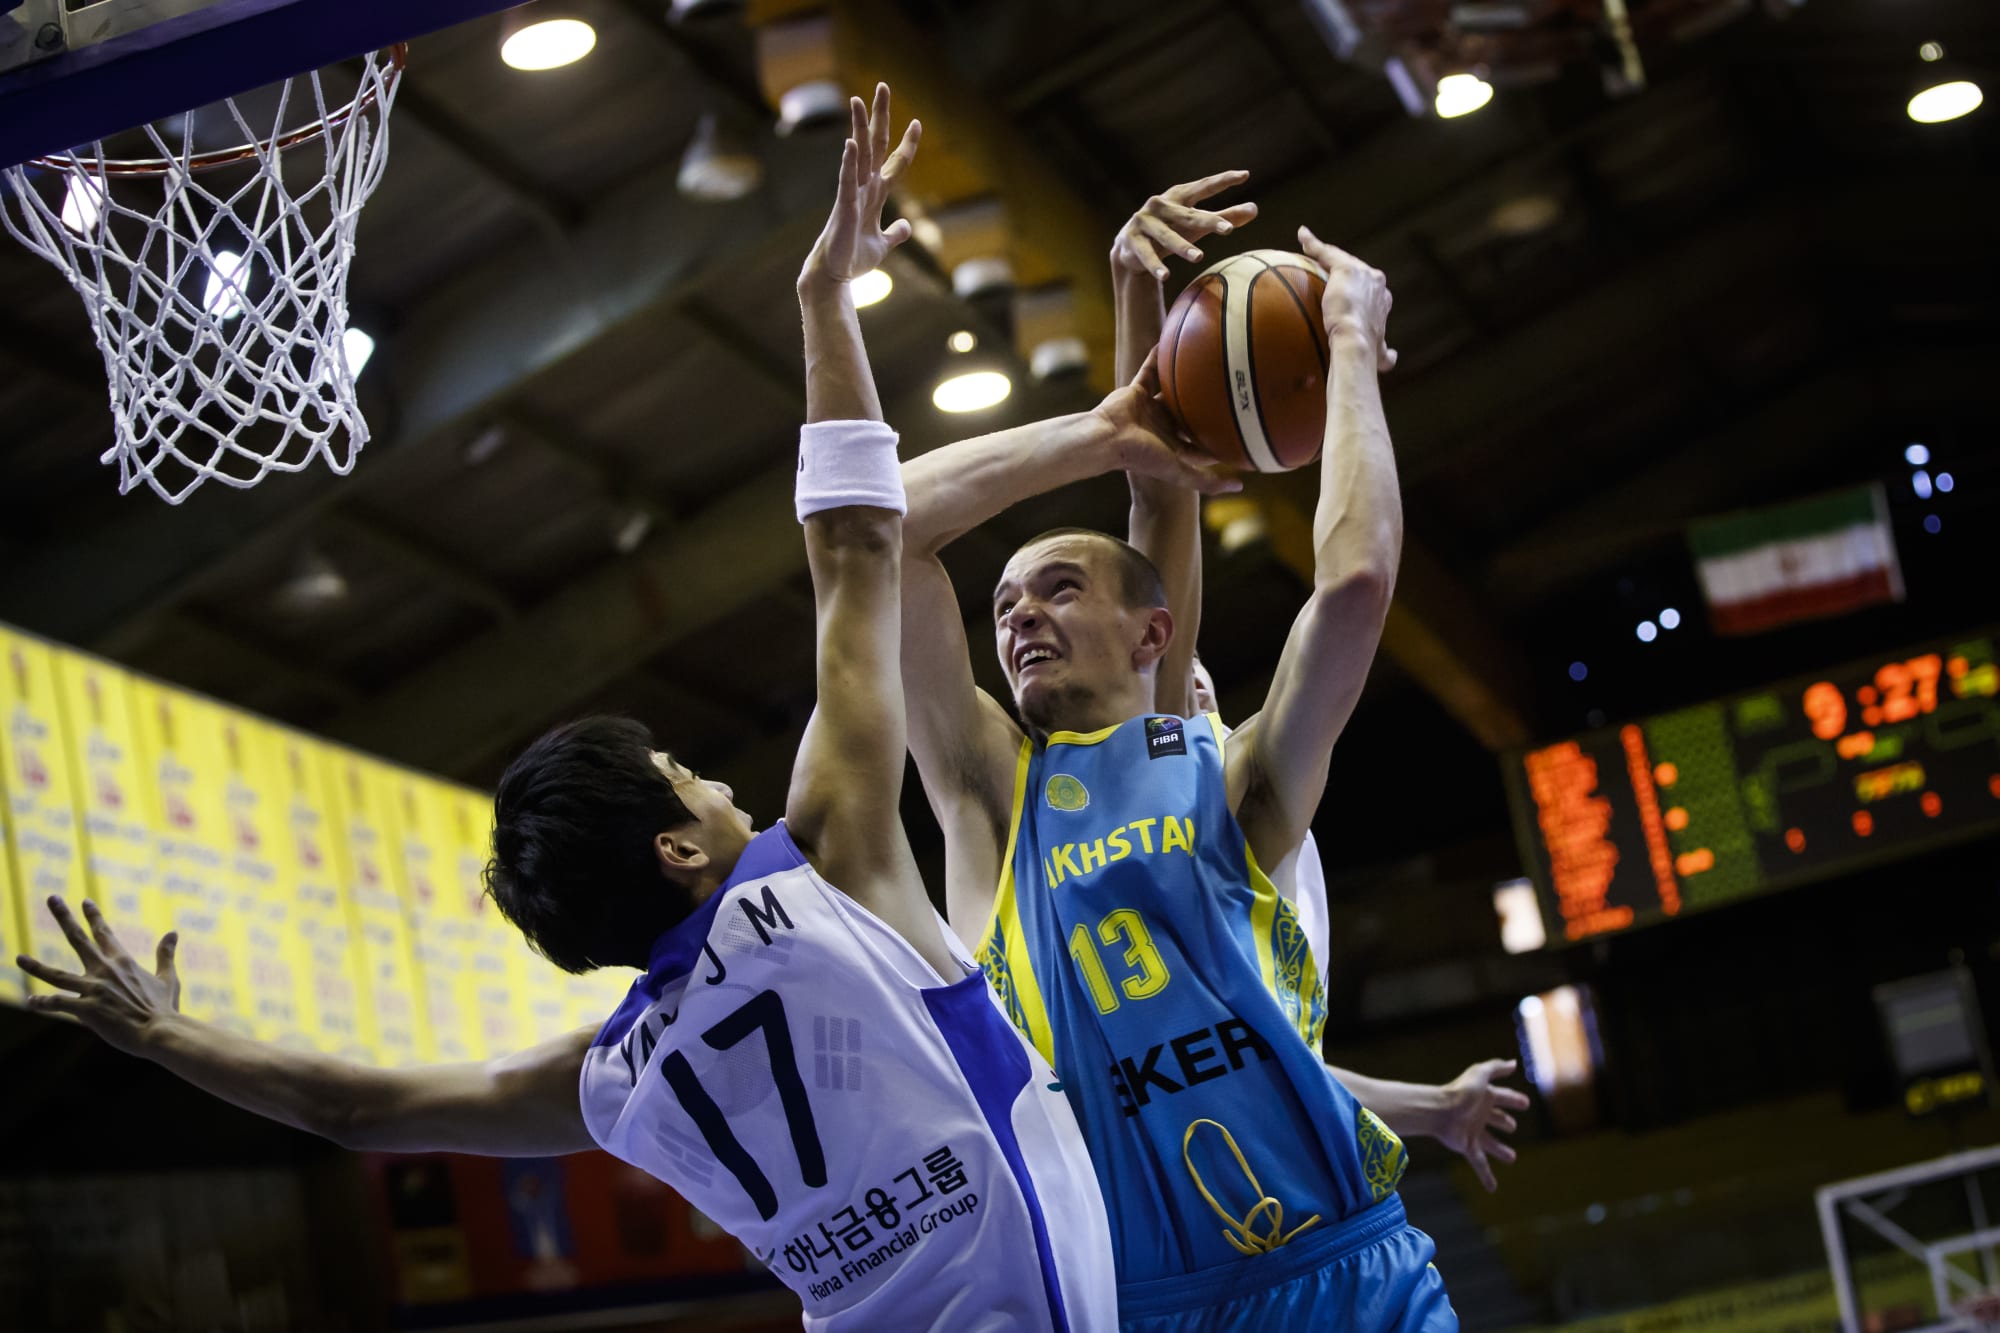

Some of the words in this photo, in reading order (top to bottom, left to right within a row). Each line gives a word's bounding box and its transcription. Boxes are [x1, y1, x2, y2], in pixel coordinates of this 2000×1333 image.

[1152, 733, 1179, 747] FIBA
[738, 885, 795, 946] M
[1069, 908, 1171, 1016] 13
[661, 989, 828, 1222] 17
[783, 1145, 969, 1275] 하나금융그룹
[808, 1275, 845, 1302] Hana
[840, 1223, 920, 1283] Financial
[920, 1192, 979, 1235] Group
